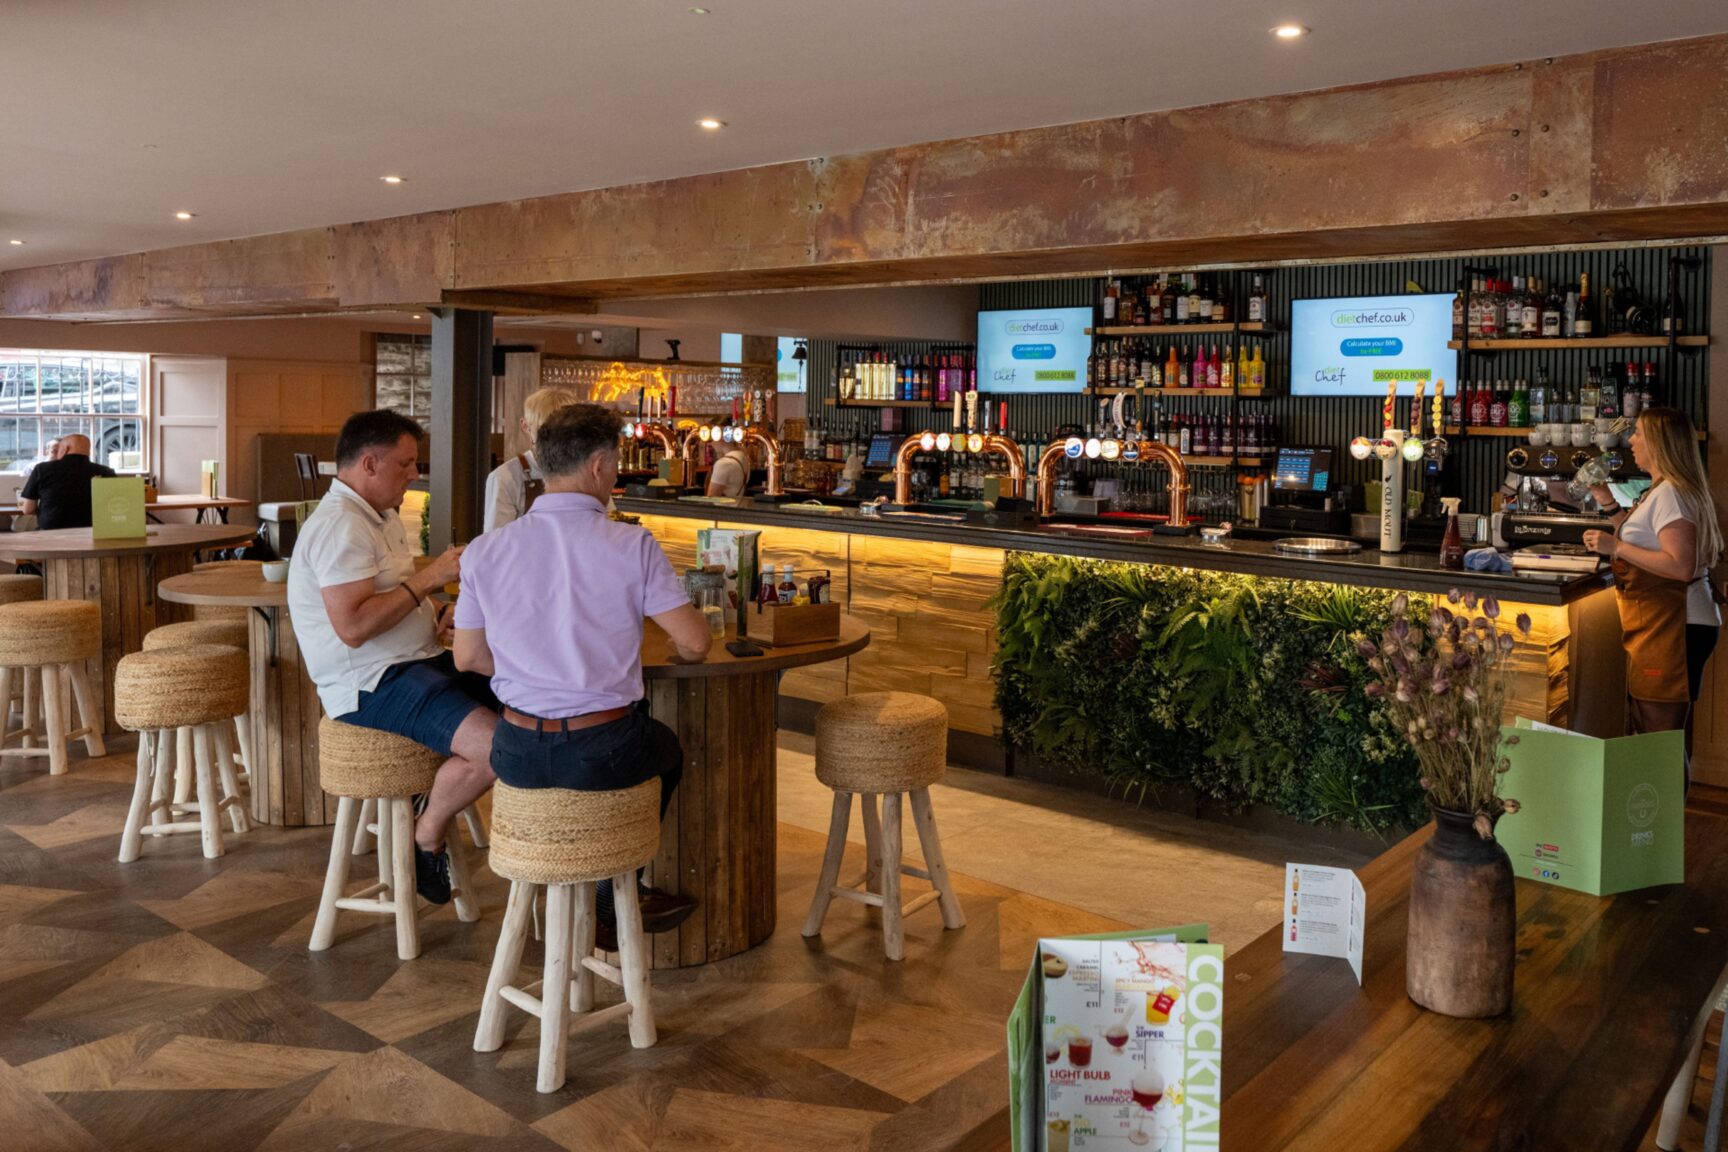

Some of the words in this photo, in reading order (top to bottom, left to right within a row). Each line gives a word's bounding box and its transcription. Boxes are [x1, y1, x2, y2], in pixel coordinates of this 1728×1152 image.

[1336, 312, 1406, 324] dietchef.co.uk
[1315, 367, 1346, 386] Chef
[1375, 371, 1393, 380] 0800
[1394, 371, 1409, 380] 612
[1135, 1030, 1164, 1038] SIPPER
[1185, 954, 1222, 1152] COCKTAI
[1050, 1069, 1081, 1079] LIGHT
[1083, 1070, 1111, 1080] BULB
[1085, 1095, 1133, 1103] FLAMINGO
[1074, 1127, 1097, 1136] APPLE
